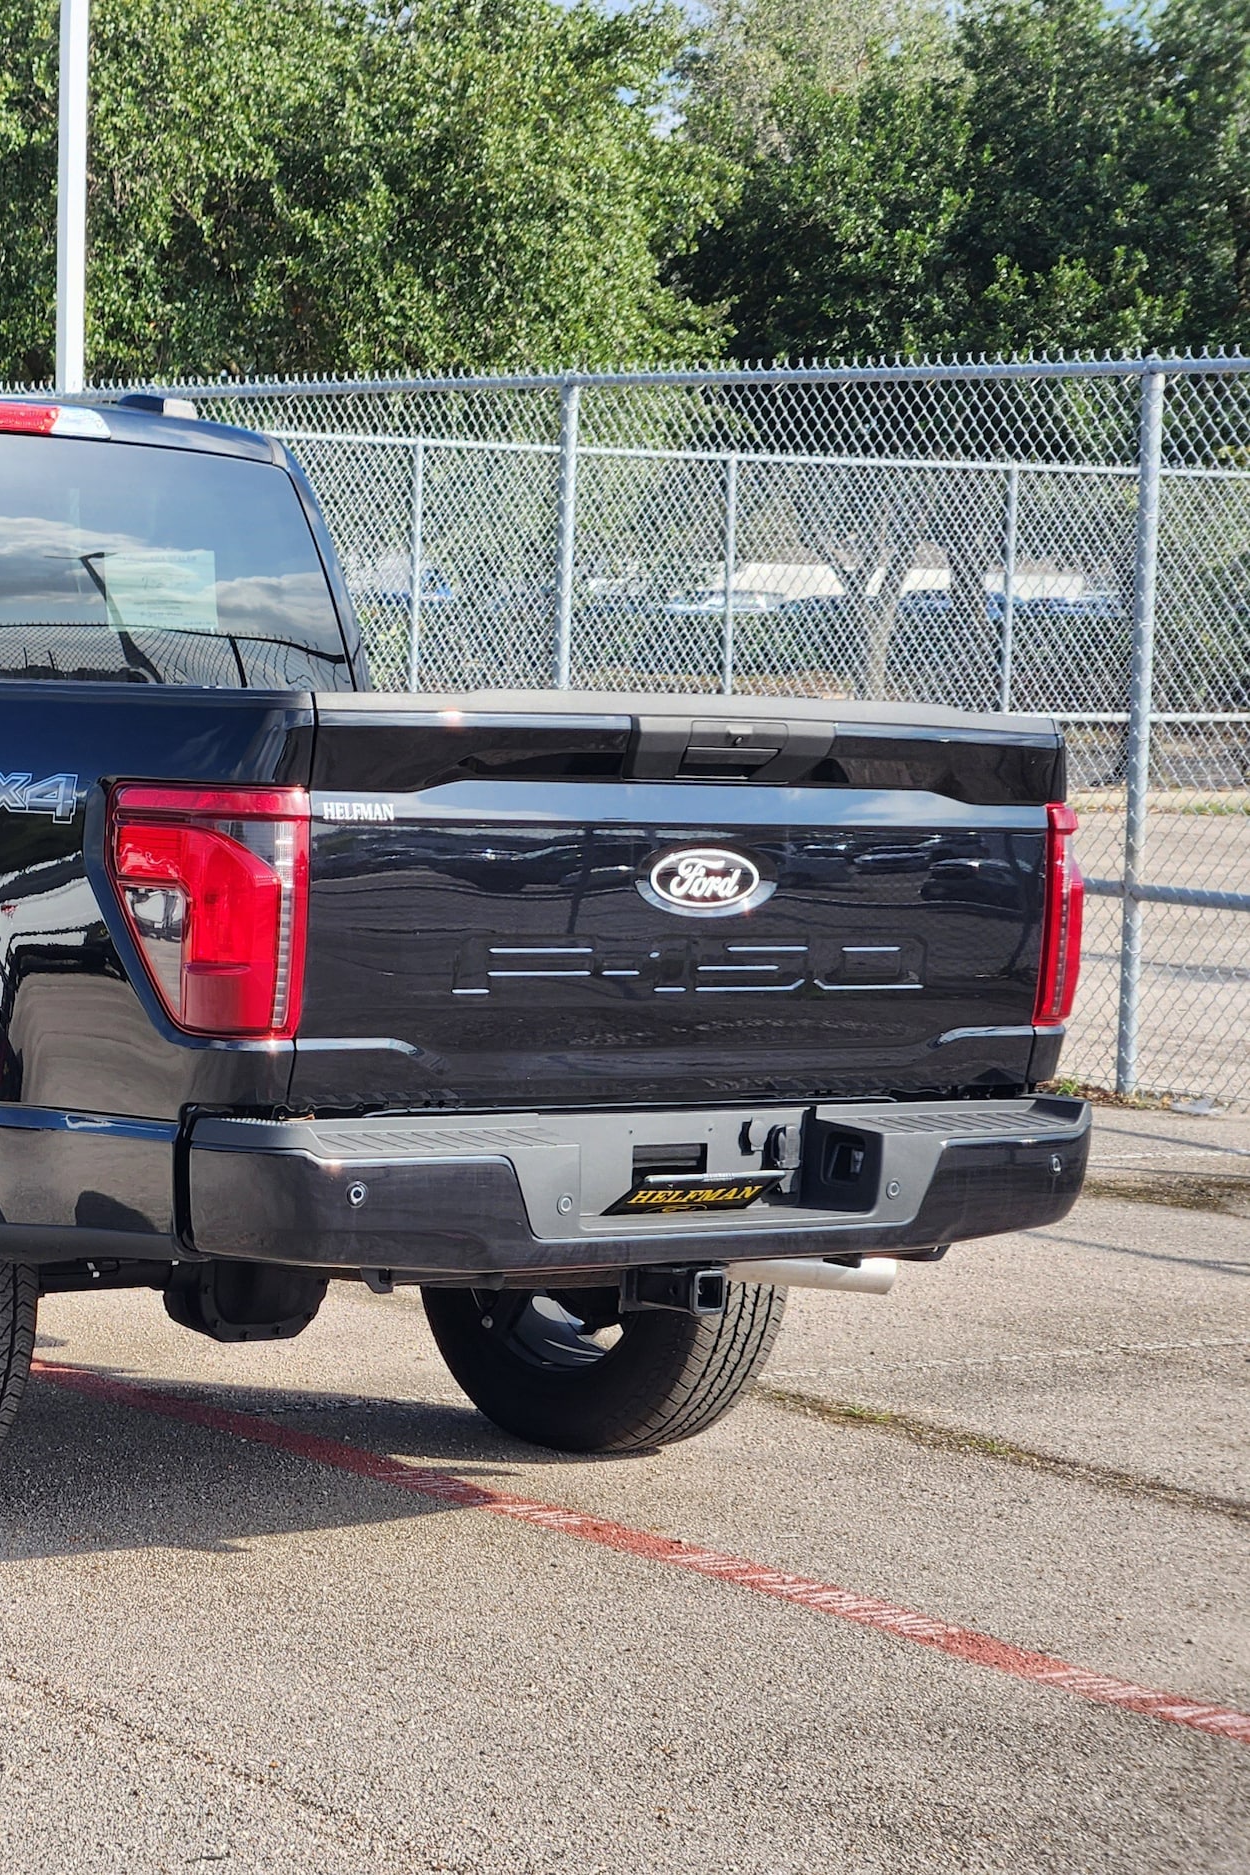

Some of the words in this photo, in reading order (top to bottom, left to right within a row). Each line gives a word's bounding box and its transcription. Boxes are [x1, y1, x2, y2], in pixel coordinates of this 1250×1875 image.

[323, 802, 395, 821] HELFMAN
[670, 858, 742, 898] Ford
[450, 934, 927, 995] F-150
[627, 1185, 763, 1204] HELFMAN
